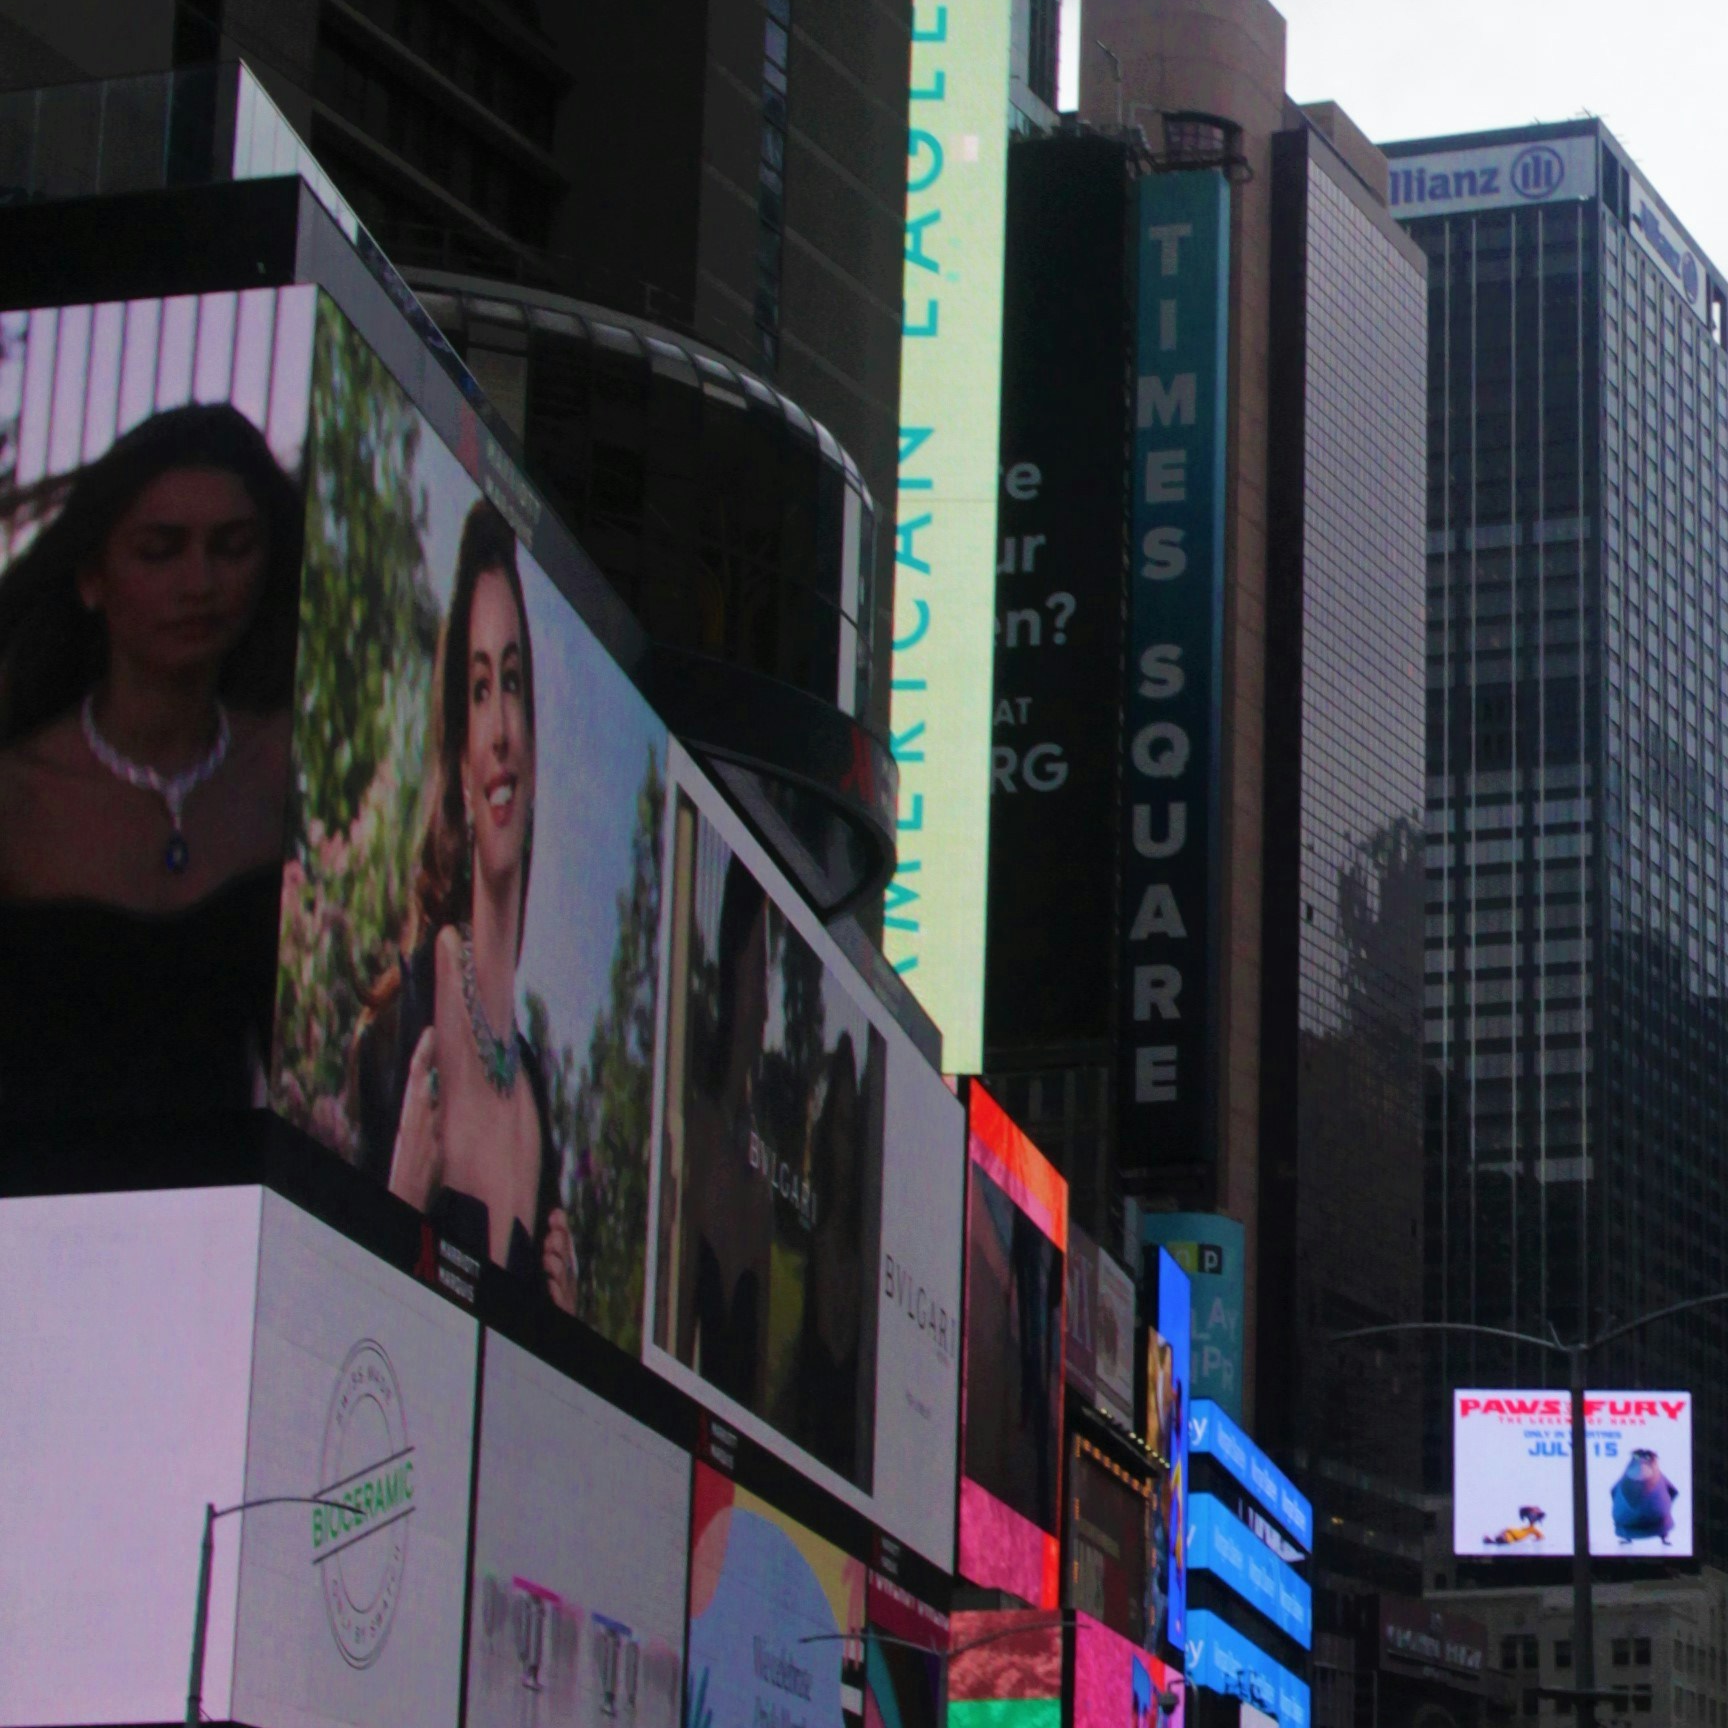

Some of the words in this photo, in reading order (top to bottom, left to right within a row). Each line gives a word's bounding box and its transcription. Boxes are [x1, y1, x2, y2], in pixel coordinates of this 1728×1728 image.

[1389, 167, 1500, 206] llianz
[1137, 222, 1197, 580] TIMES
[882, 427, 933, 975] MERICAN
[1128, 642, 1190, 1103] SQUARE
[886, 1253, 957, 1358] BVLGARI
[1460, 1399, 1561, 1418] PAWS
[1584, 1400, 1686, 1420] FURY
[1530, 1417, 1573, 1425] LEGEN
[1594, 1442, 1618, 1457] 15
[312, 1459, 413, 1548] BIOCERAMIC
